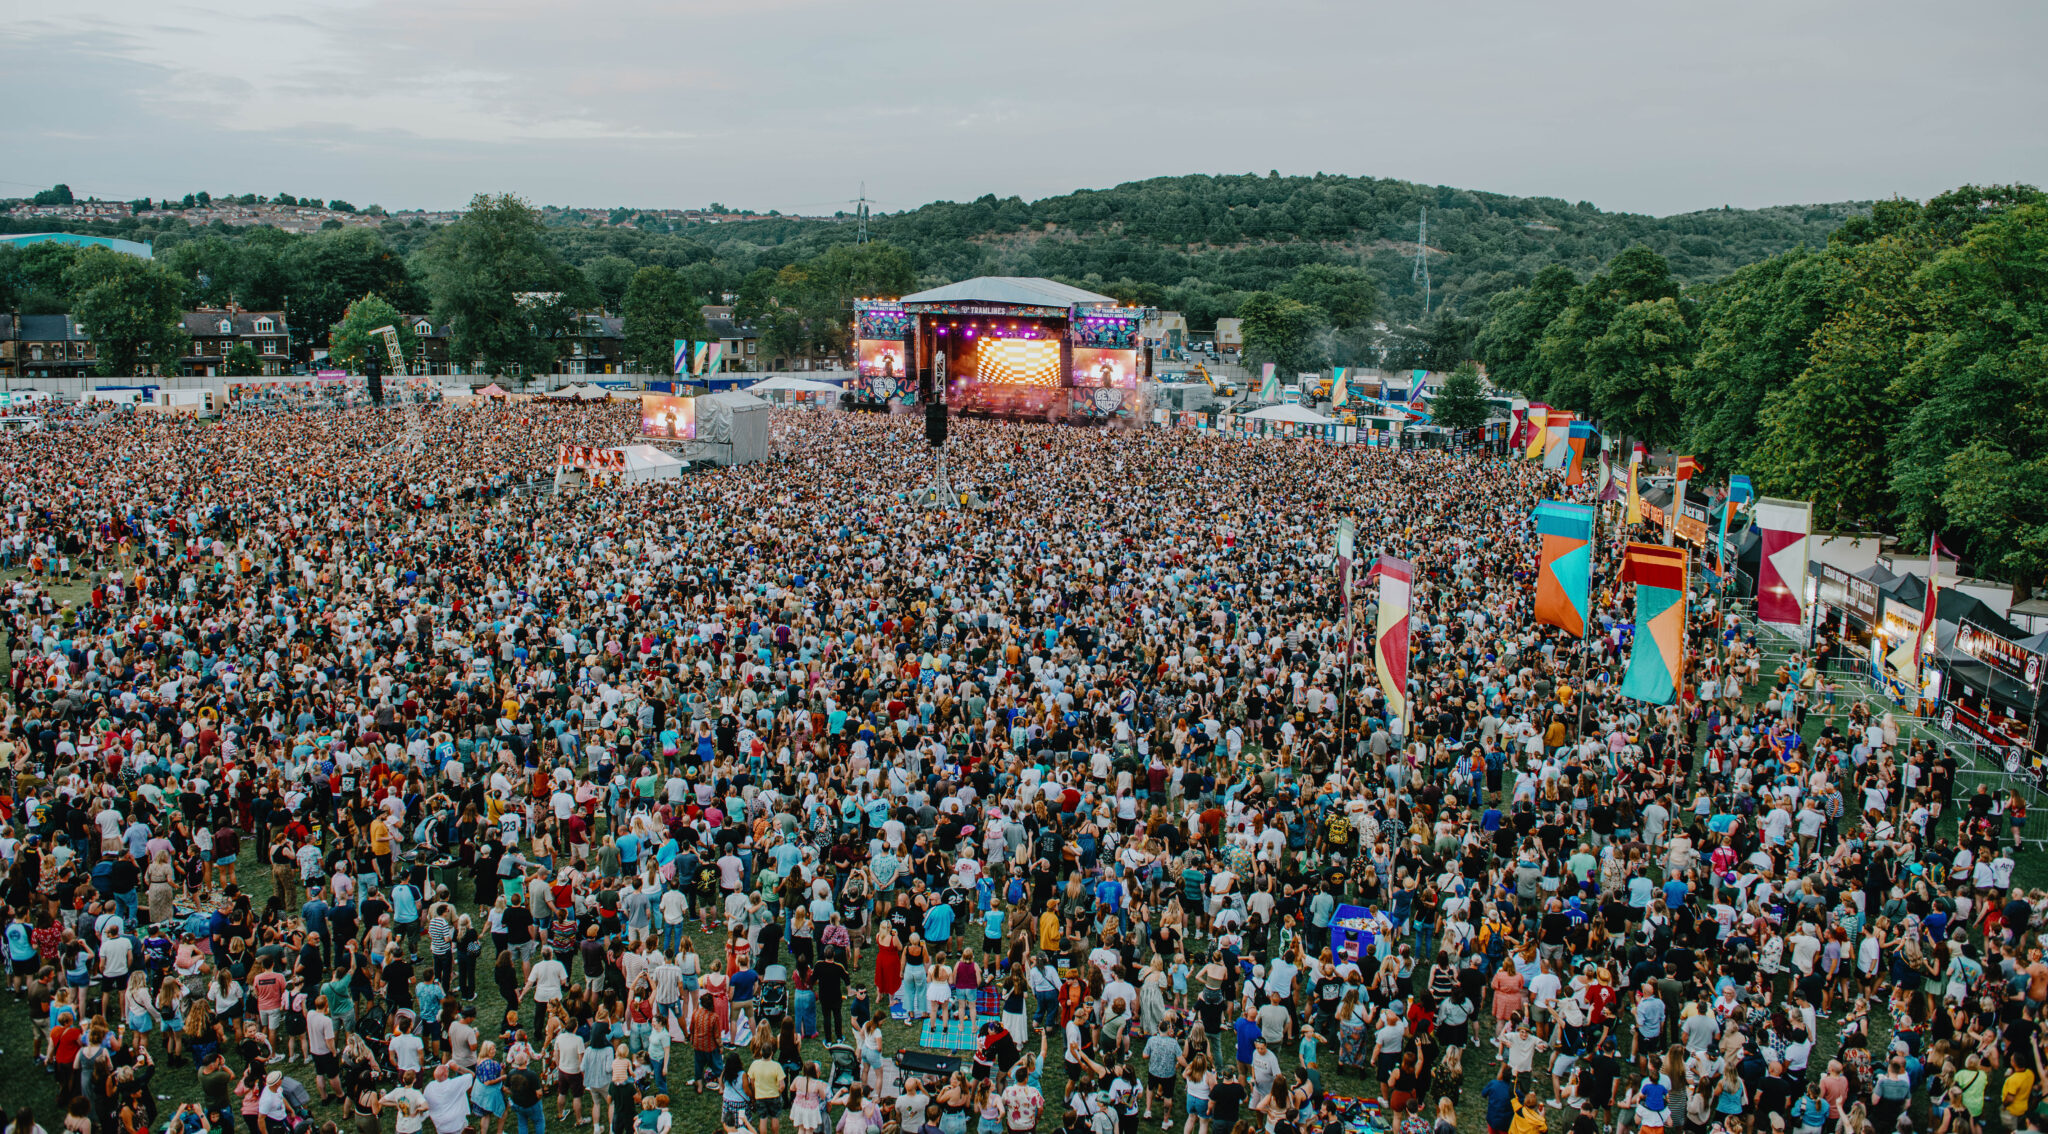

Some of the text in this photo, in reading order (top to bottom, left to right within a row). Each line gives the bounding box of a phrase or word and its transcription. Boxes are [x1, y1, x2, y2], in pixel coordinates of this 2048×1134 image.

[971, 306, 1006, 315] TRAMLINES
[442, 746, 453, 758] 10
[875, 803, 886, 813] 25
[502, 820, 516, 832] 23
[948, 894, 963, 905] 25
[1571, 915, 1582, 927] 10
[1718, 912, 1729, 925] 25
